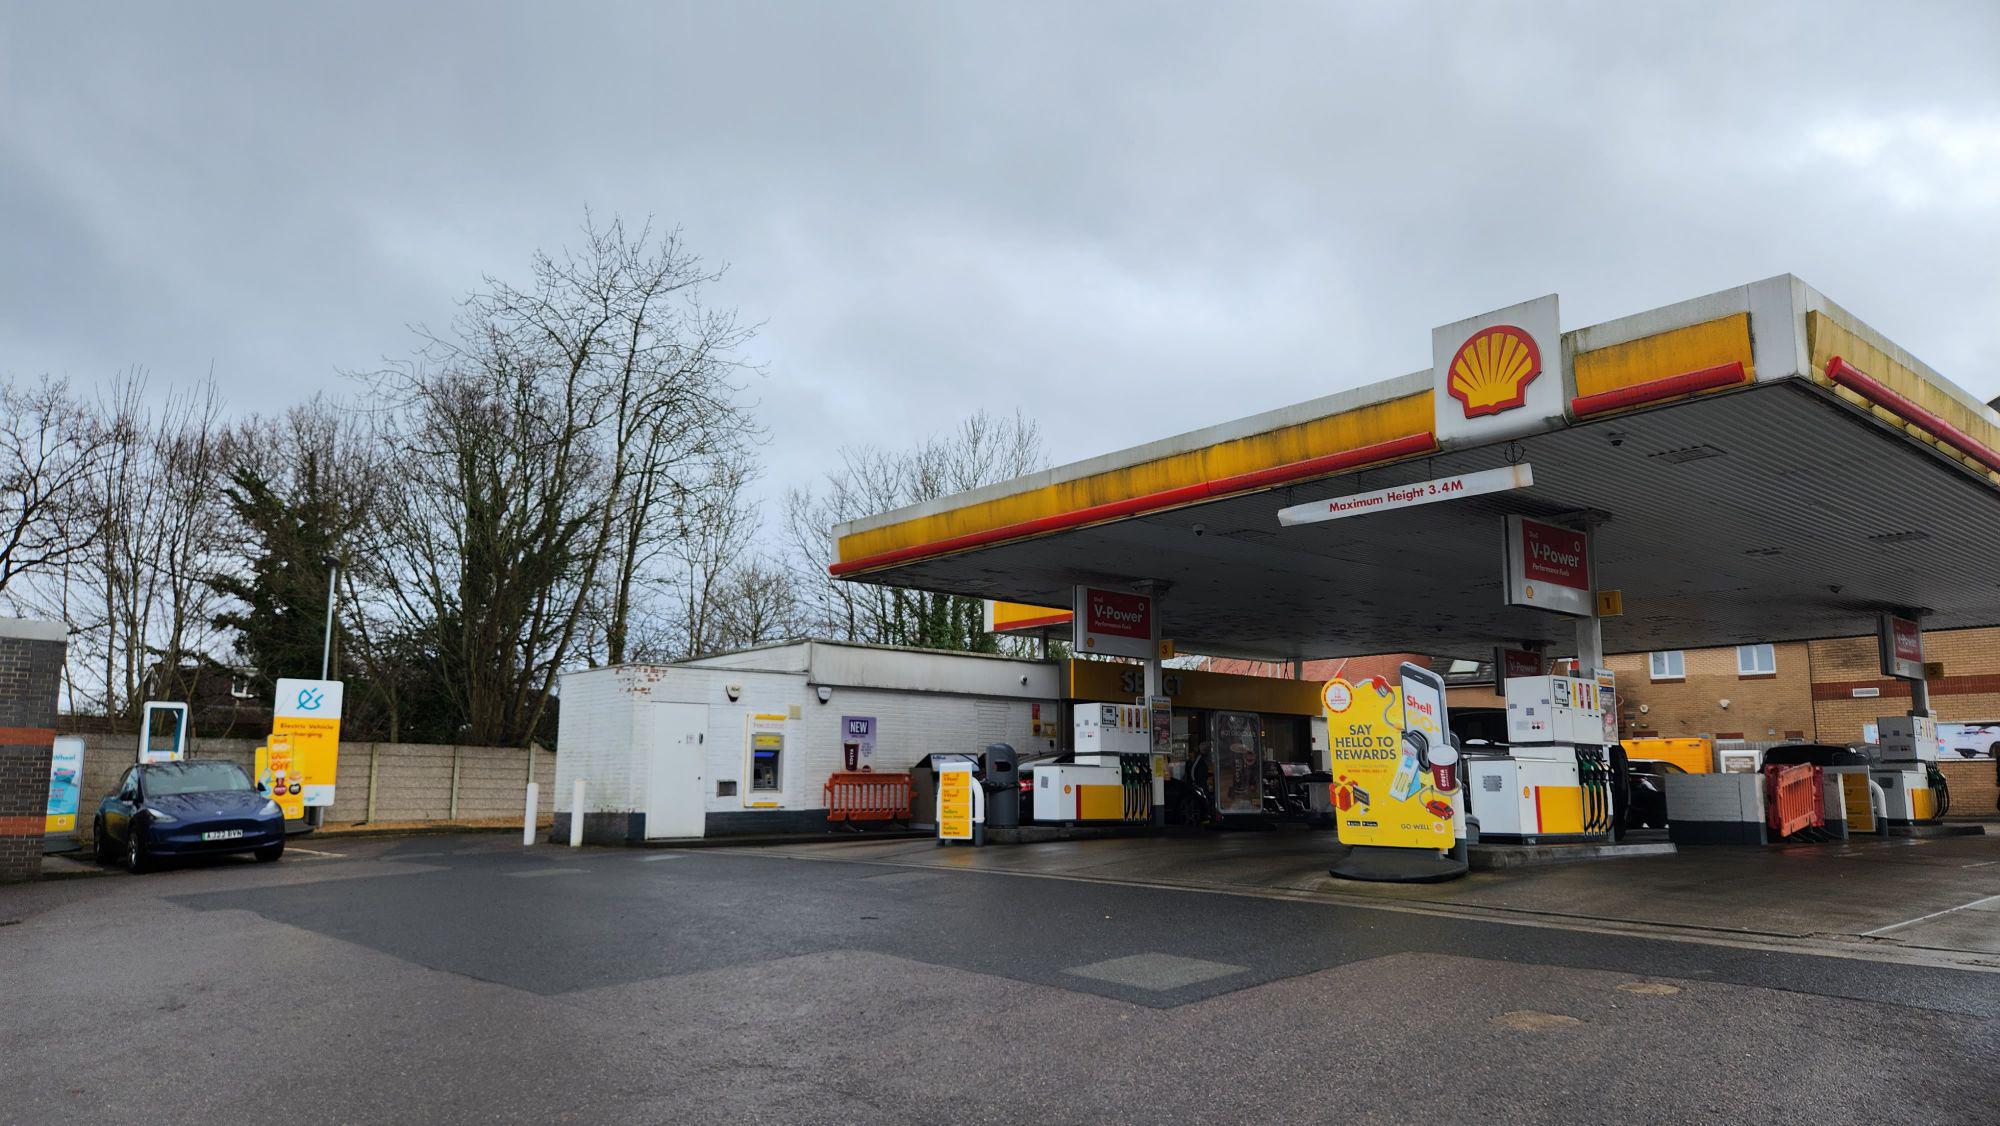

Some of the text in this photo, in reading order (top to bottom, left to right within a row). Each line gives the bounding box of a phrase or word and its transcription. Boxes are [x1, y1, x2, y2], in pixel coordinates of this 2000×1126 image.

[1329, 497, 1383, 512] Maximum
[1387, 487, 1424, 502] Height
[1530, 541, 1579, 568] V-Power
[1605, 597, 1611, 609] 1
[1094, 604, 1143, 623] V-Power
[1161, 645, 1168, 654] 3
[1123, 671, 1183, 696] SECT
[1406, 695, 1432, 715] Shell
[850, 721, 868, 733] NEW
[1349, 724, 1372, 735] SAY
[1335, 736, 1394, 748] HELLO TO
[1335, 749, 1397, 760] REWARDS
